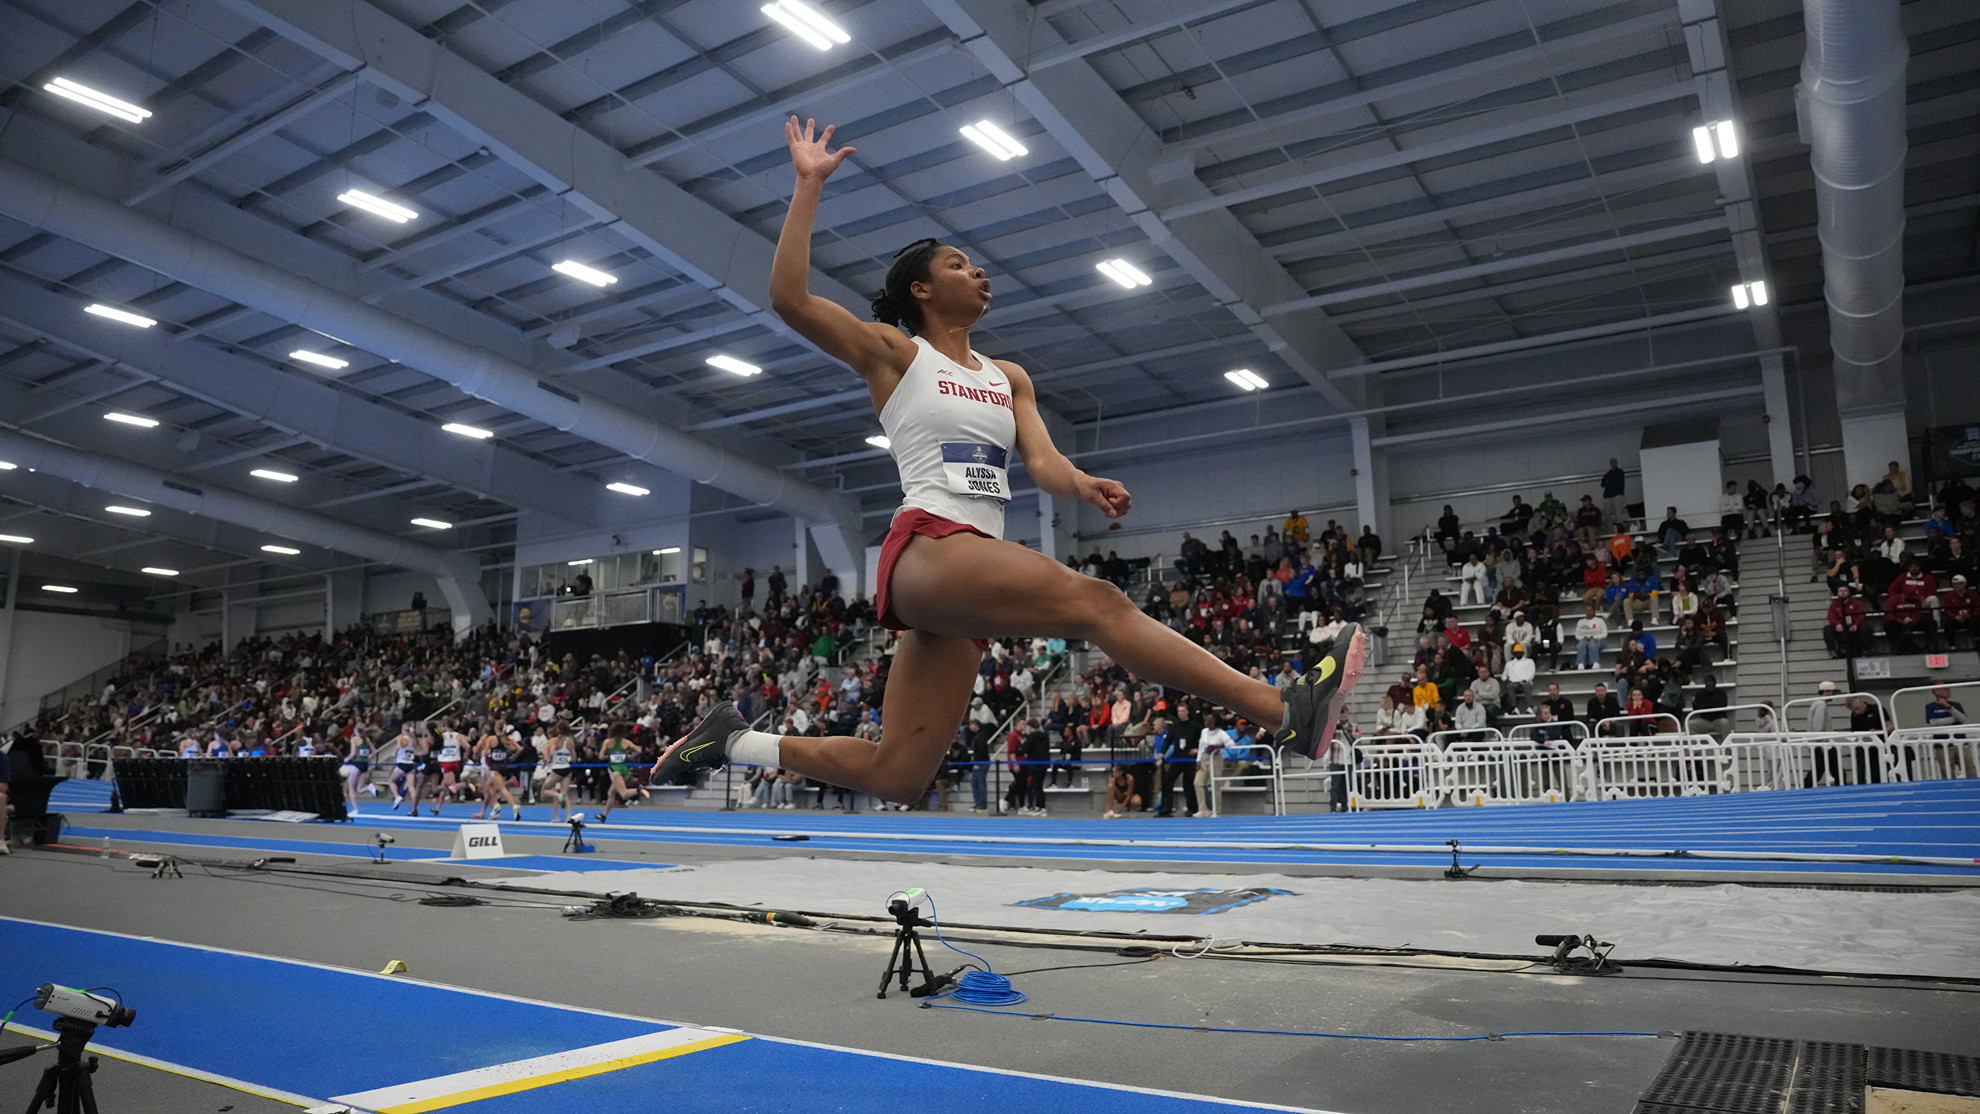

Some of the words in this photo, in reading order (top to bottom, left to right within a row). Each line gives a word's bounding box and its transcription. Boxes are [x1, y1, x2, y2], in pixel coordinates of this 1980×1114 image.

[938, 369, 954, 377] ACC
[966, 467, 996, 480] ALYSSA
[968, 481, 1000, 494] JONES
[1929, 655, 1946, 667] EXIT
[469, 837, 498, 847] GILL
